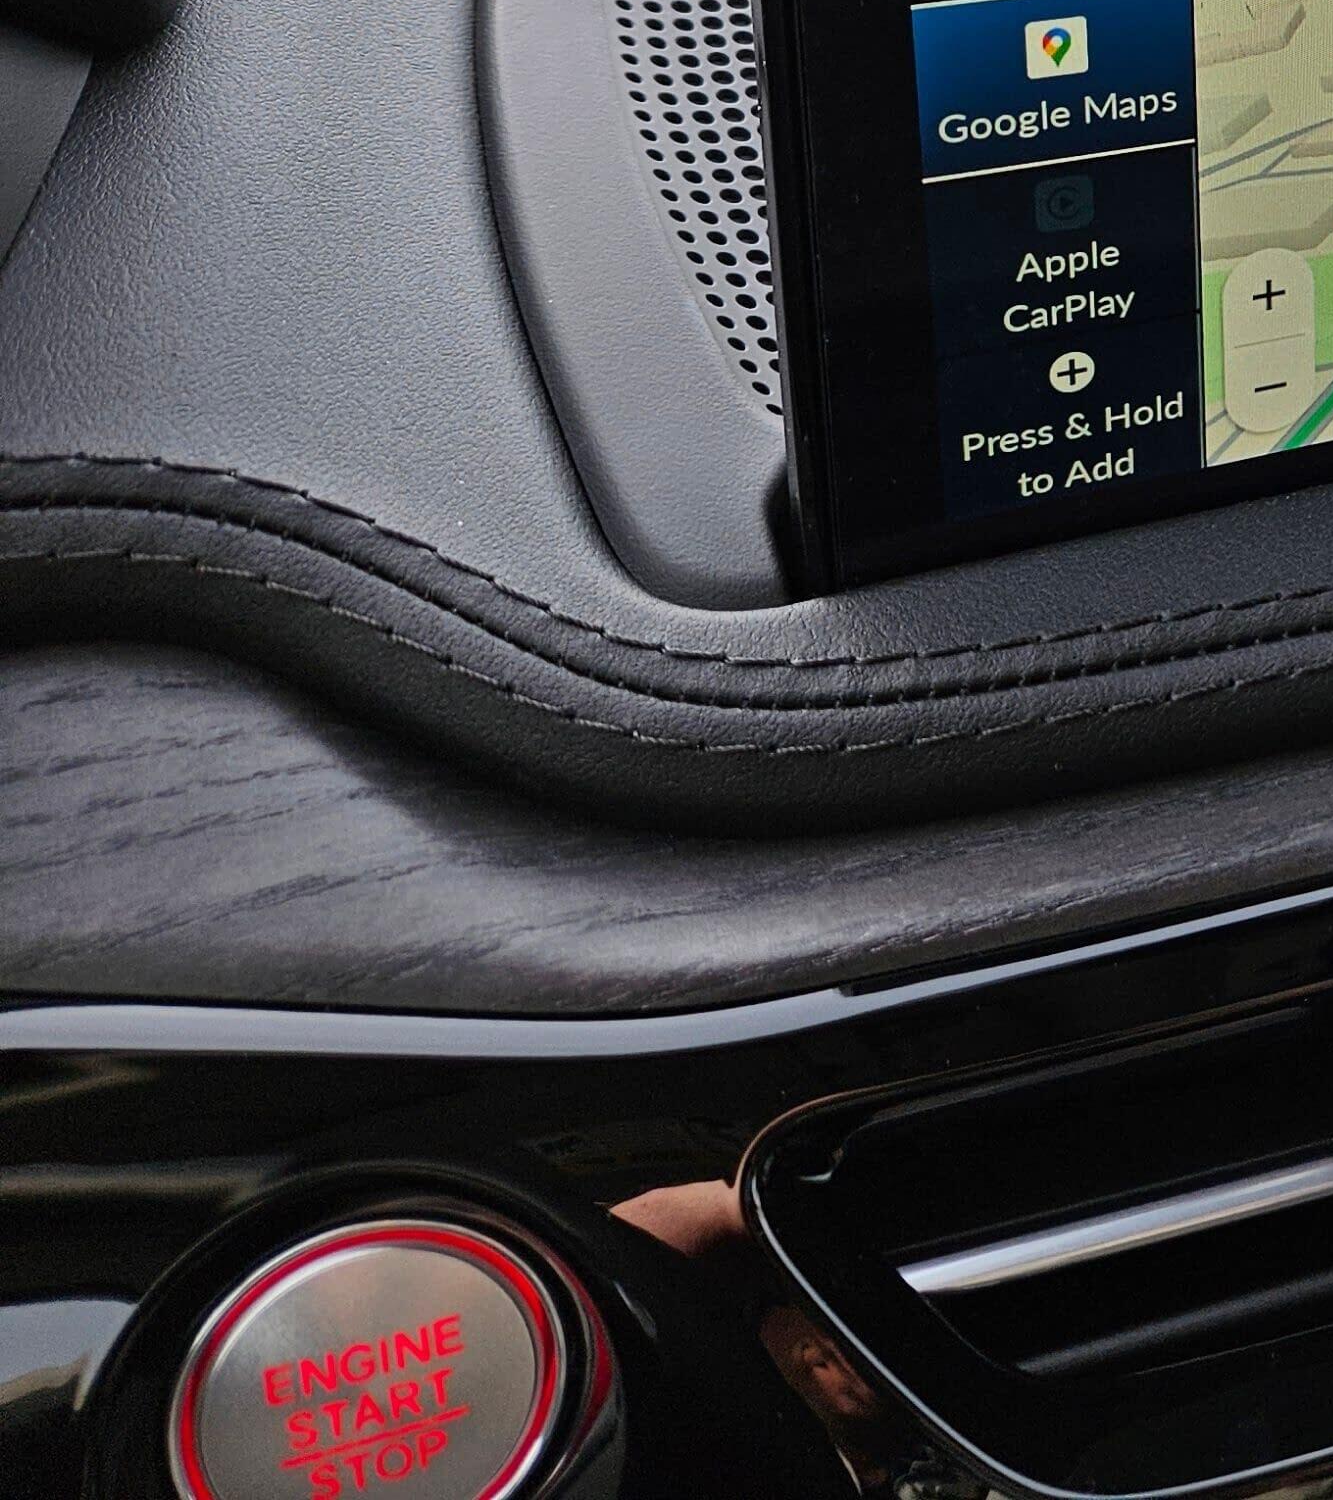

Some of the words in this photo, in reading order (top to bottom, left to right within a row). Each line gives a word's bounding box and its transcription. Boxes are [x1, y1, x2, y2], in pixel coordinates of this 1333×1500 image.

[937, 102, 1071, 144] Google
[1084, 88, 1177, 122] Maps
[1016, 240, 1120, 283] Apple
[1002, 289, 1135, 332] CarPlay
[962, 424, 1054, 462] Press
[1064, 414, 1092, 440] &
[1104, 391, 1184, 431] Hold
[1016, 468, 1053, 497] to
[1064, 448, 1135, 488] Add
[262, 1313, 466, 1407] ENGINE
[287, 1368, 455, 1450] START
[310, 1427, 449, 1500] STOP
